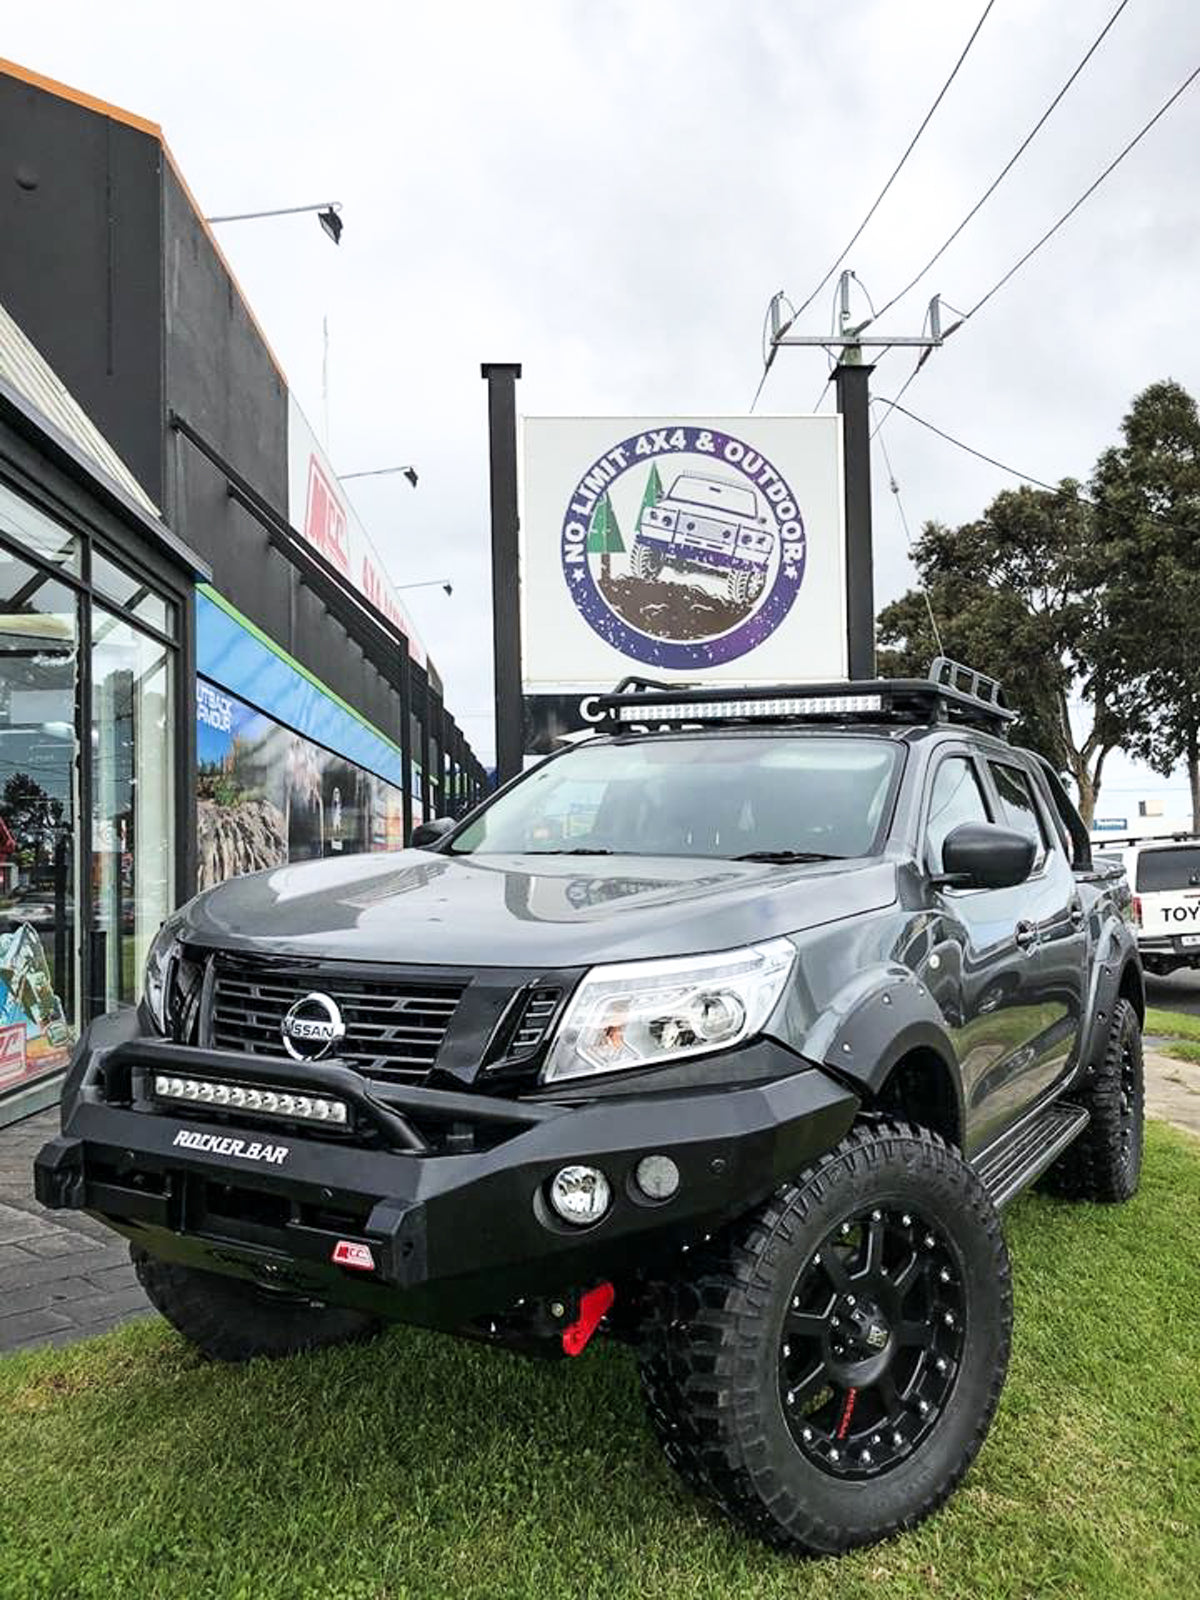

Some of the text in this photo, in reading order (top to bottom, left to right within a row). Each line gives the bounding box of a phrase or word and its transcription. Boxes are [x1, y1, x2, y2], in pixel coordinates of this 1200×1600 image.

[564, 429, 804, 563] NO LIMIT 4X4 & OUTDOOR
[173, 1130, 289, 1164] ROCKER BAR
